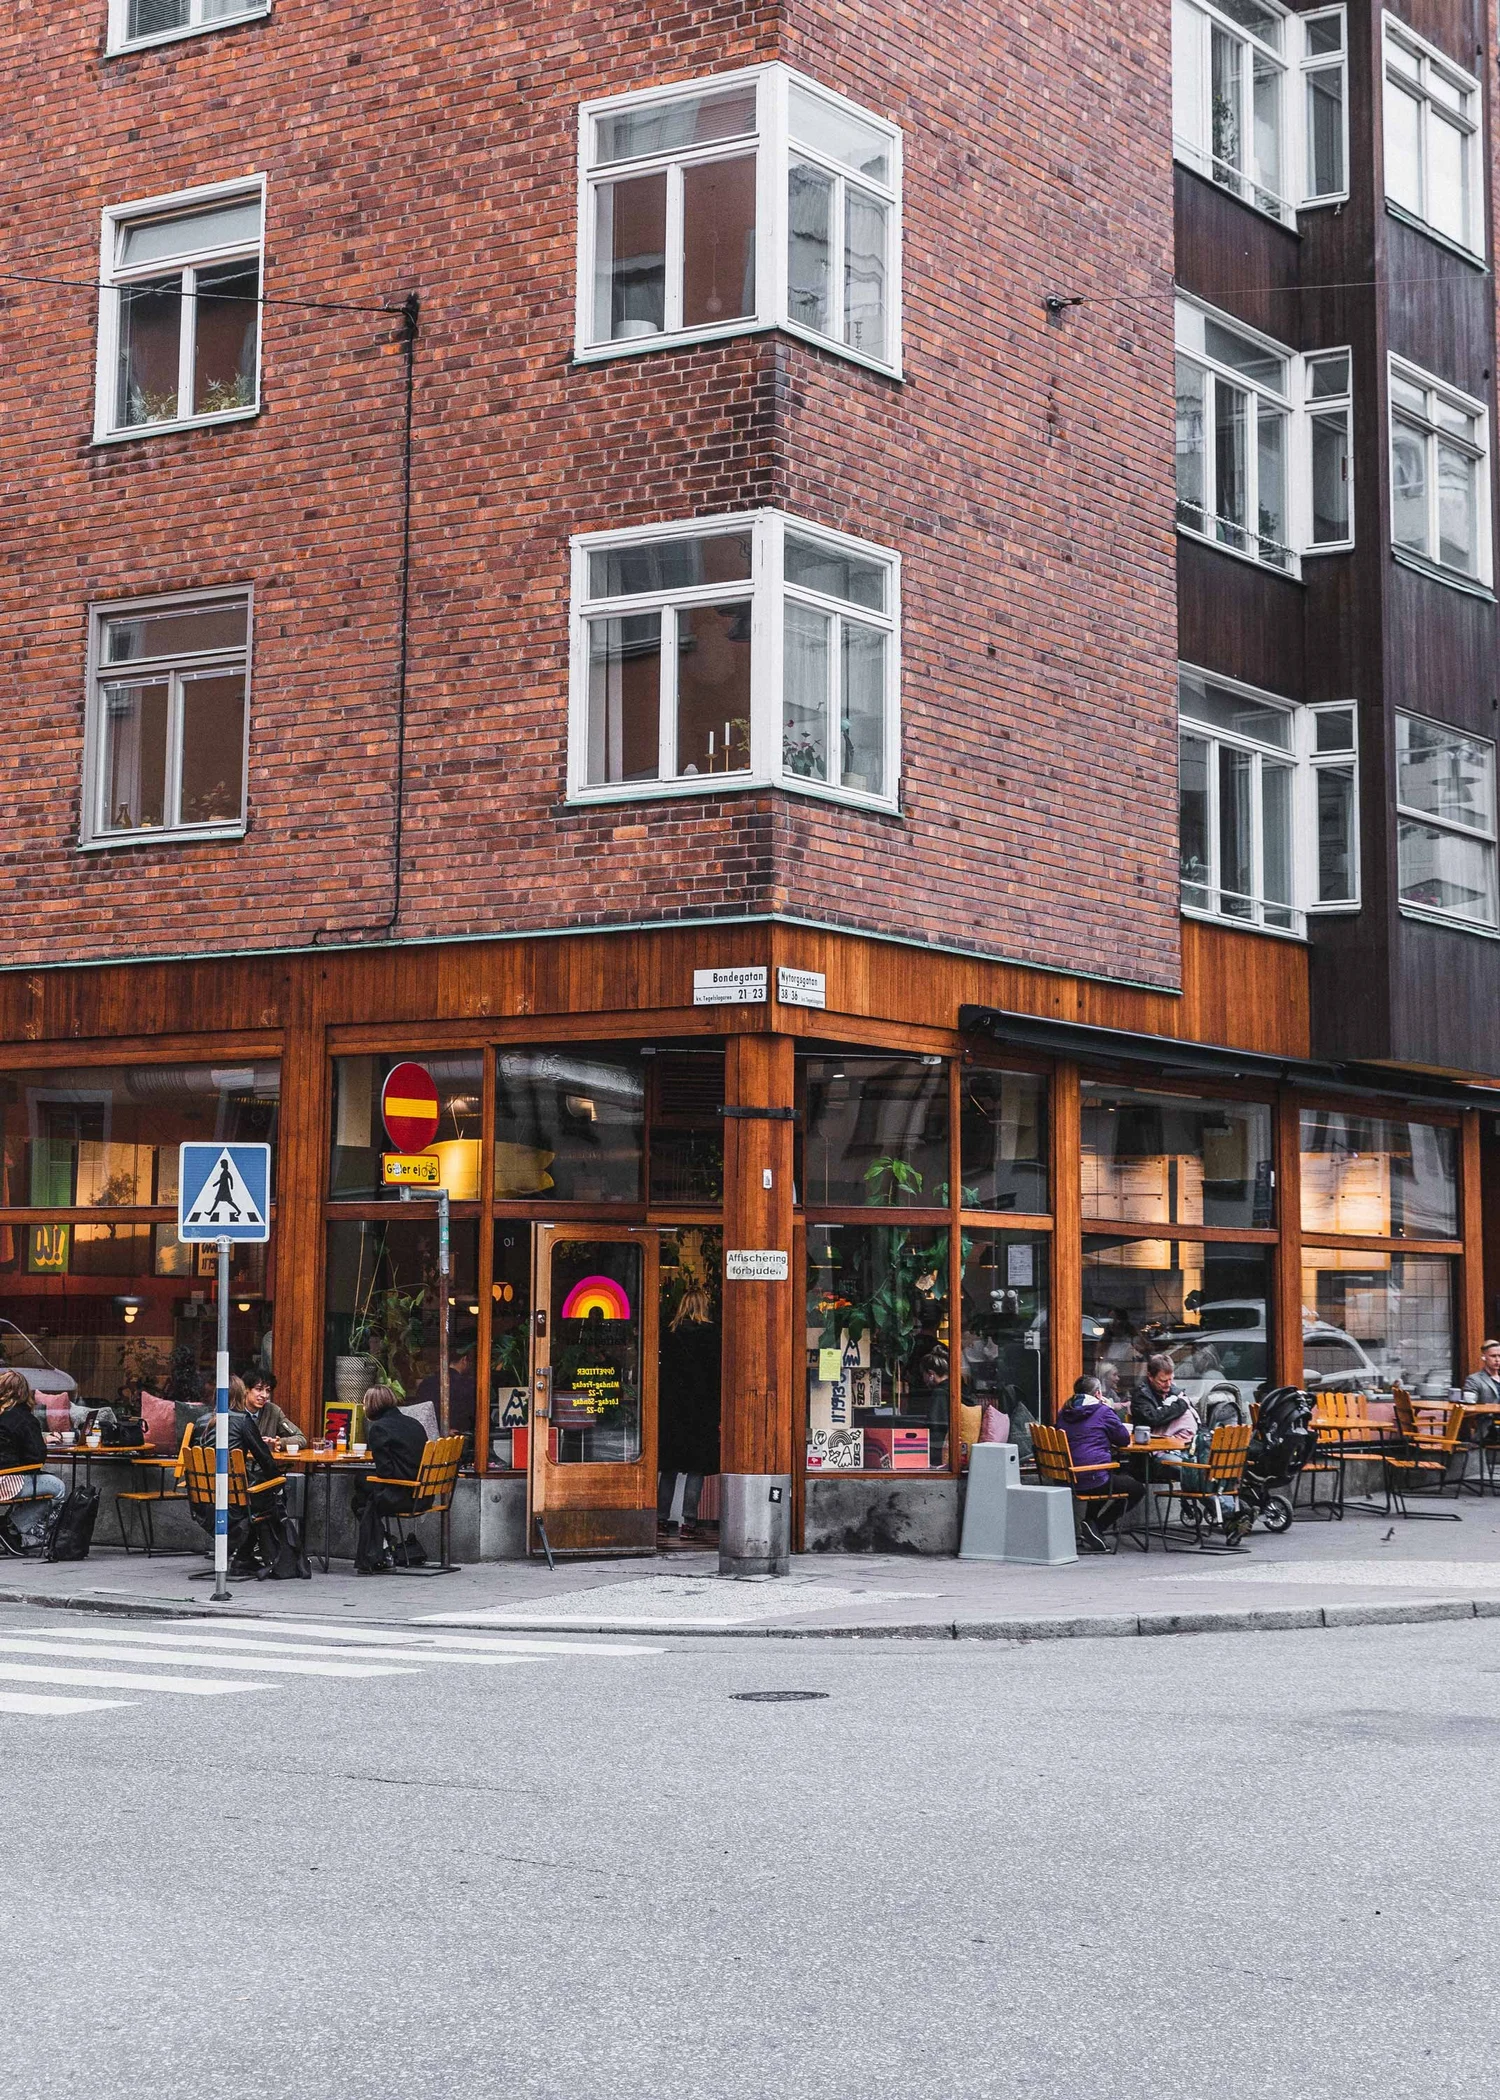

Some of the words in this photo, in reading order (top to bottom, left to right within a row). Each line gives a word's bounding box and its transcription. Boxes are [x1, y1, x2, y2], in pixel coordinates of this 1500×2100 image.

[713, 971, 763, 984] Bondegatan
[781, 971, 817, 987] Nytorgsgatan
[413, 1164, 420, 1176] ej
[728, 1253, 786, 1264] Affischering
